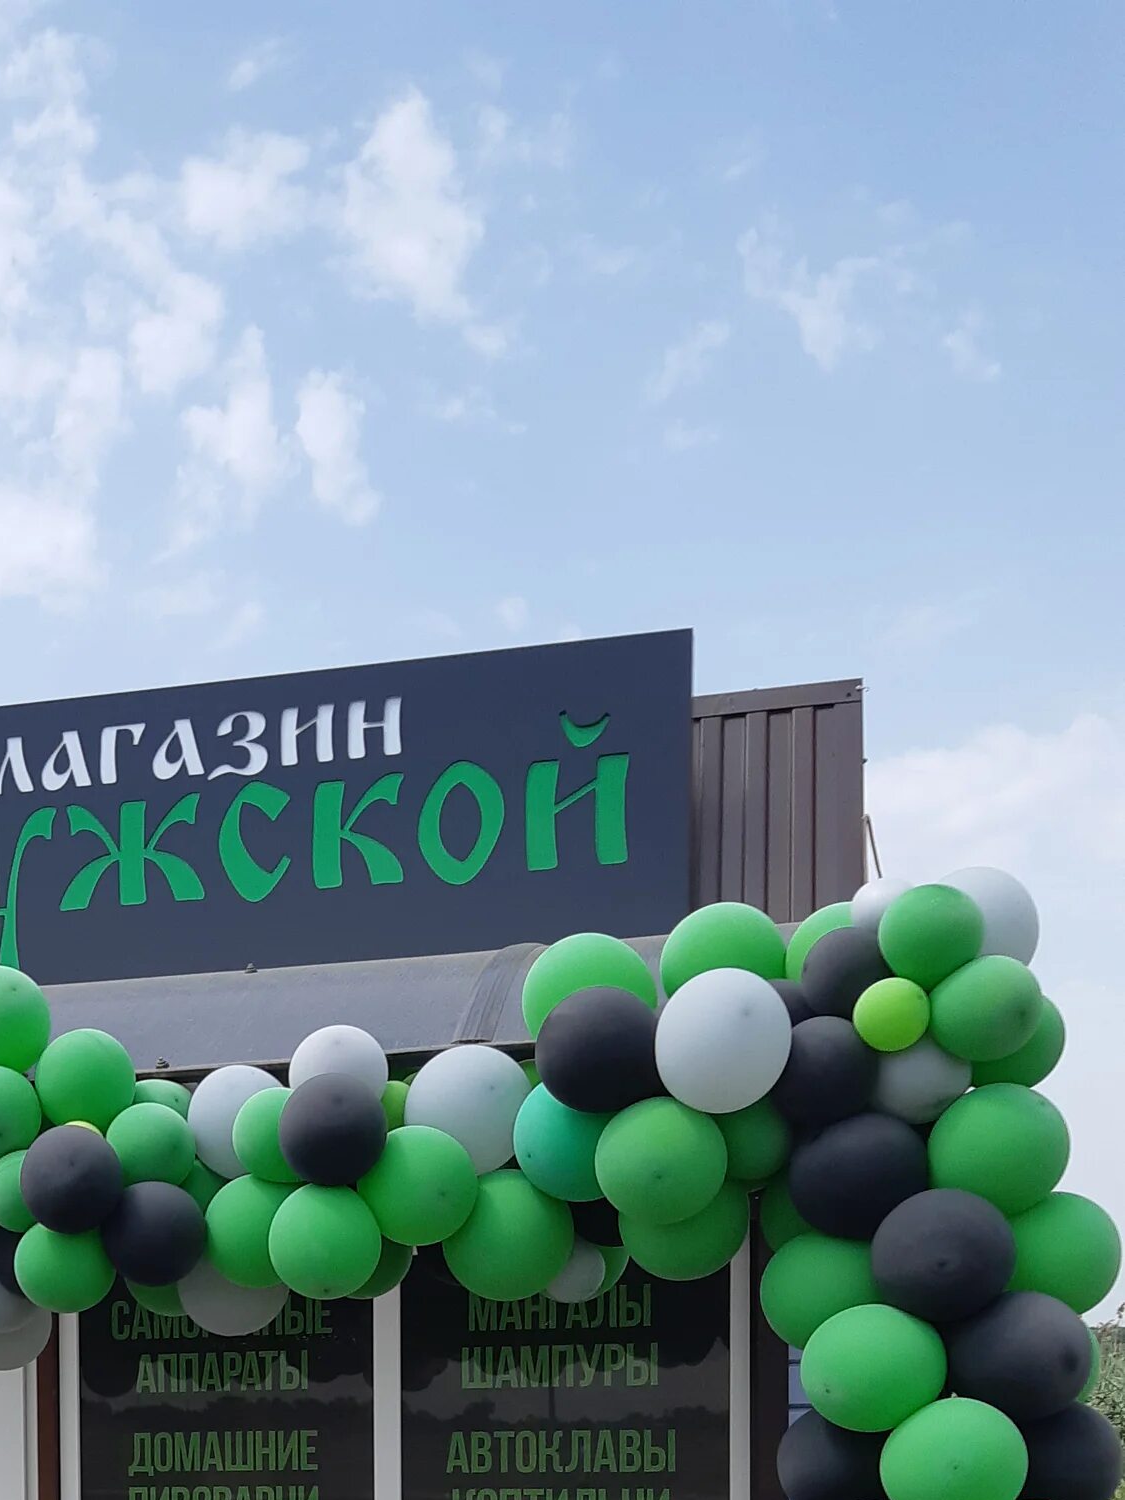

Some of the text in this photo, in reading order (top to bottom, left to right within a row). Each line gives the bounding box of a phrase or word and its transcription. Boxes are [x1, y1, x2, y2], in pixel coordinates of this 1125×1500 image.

[136, 1350, 309, 1394] АППАРАТЫ
[461, 1343, 659, 1390] ШАМПУРЫ
[128, 1430, 318, 1476] ДОМАШНИЕ
[446, 1429, 676, 1474] АВТОКЛАВЫ
